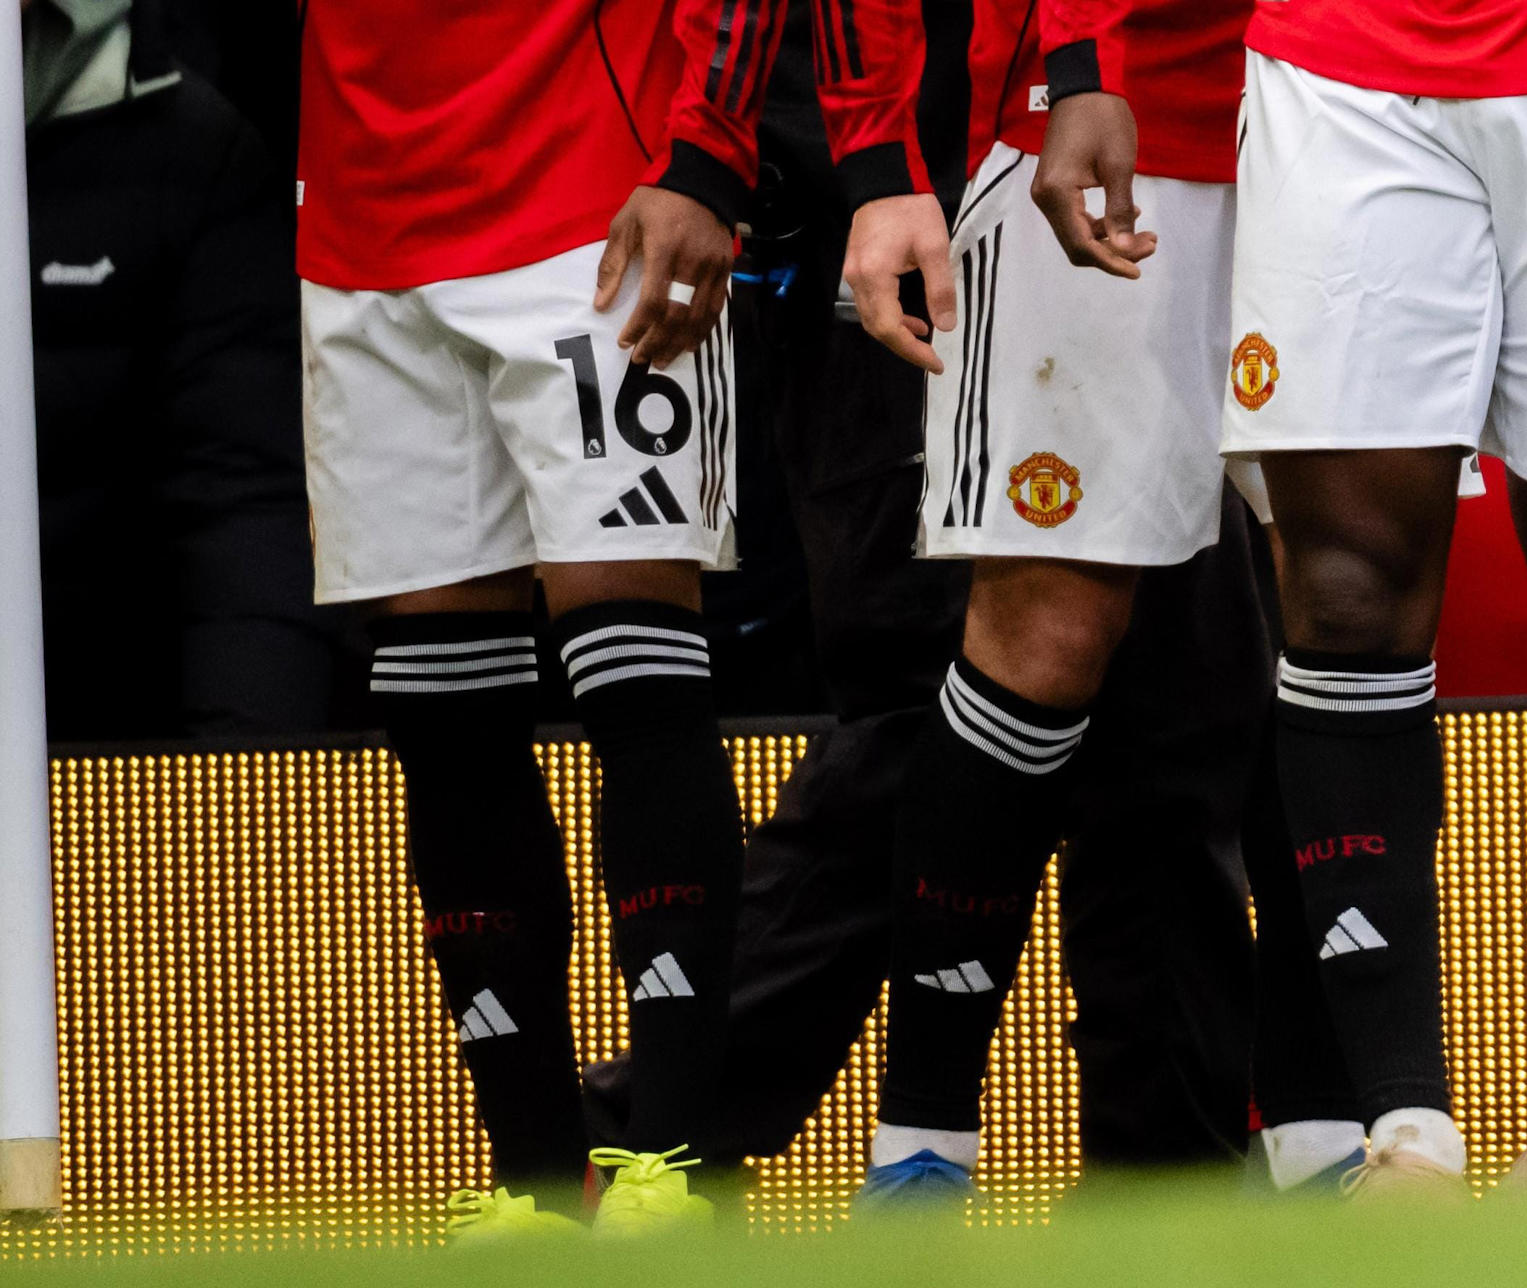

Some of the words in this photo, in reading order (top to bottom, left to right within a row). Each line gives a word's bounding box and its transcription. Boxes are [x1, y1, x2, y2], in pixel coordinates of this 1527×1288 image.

[554, 333, 693, 460] 16
[1295, 834, 1387, 872] MUFC
[619, 884, 705, 919] MUFC
